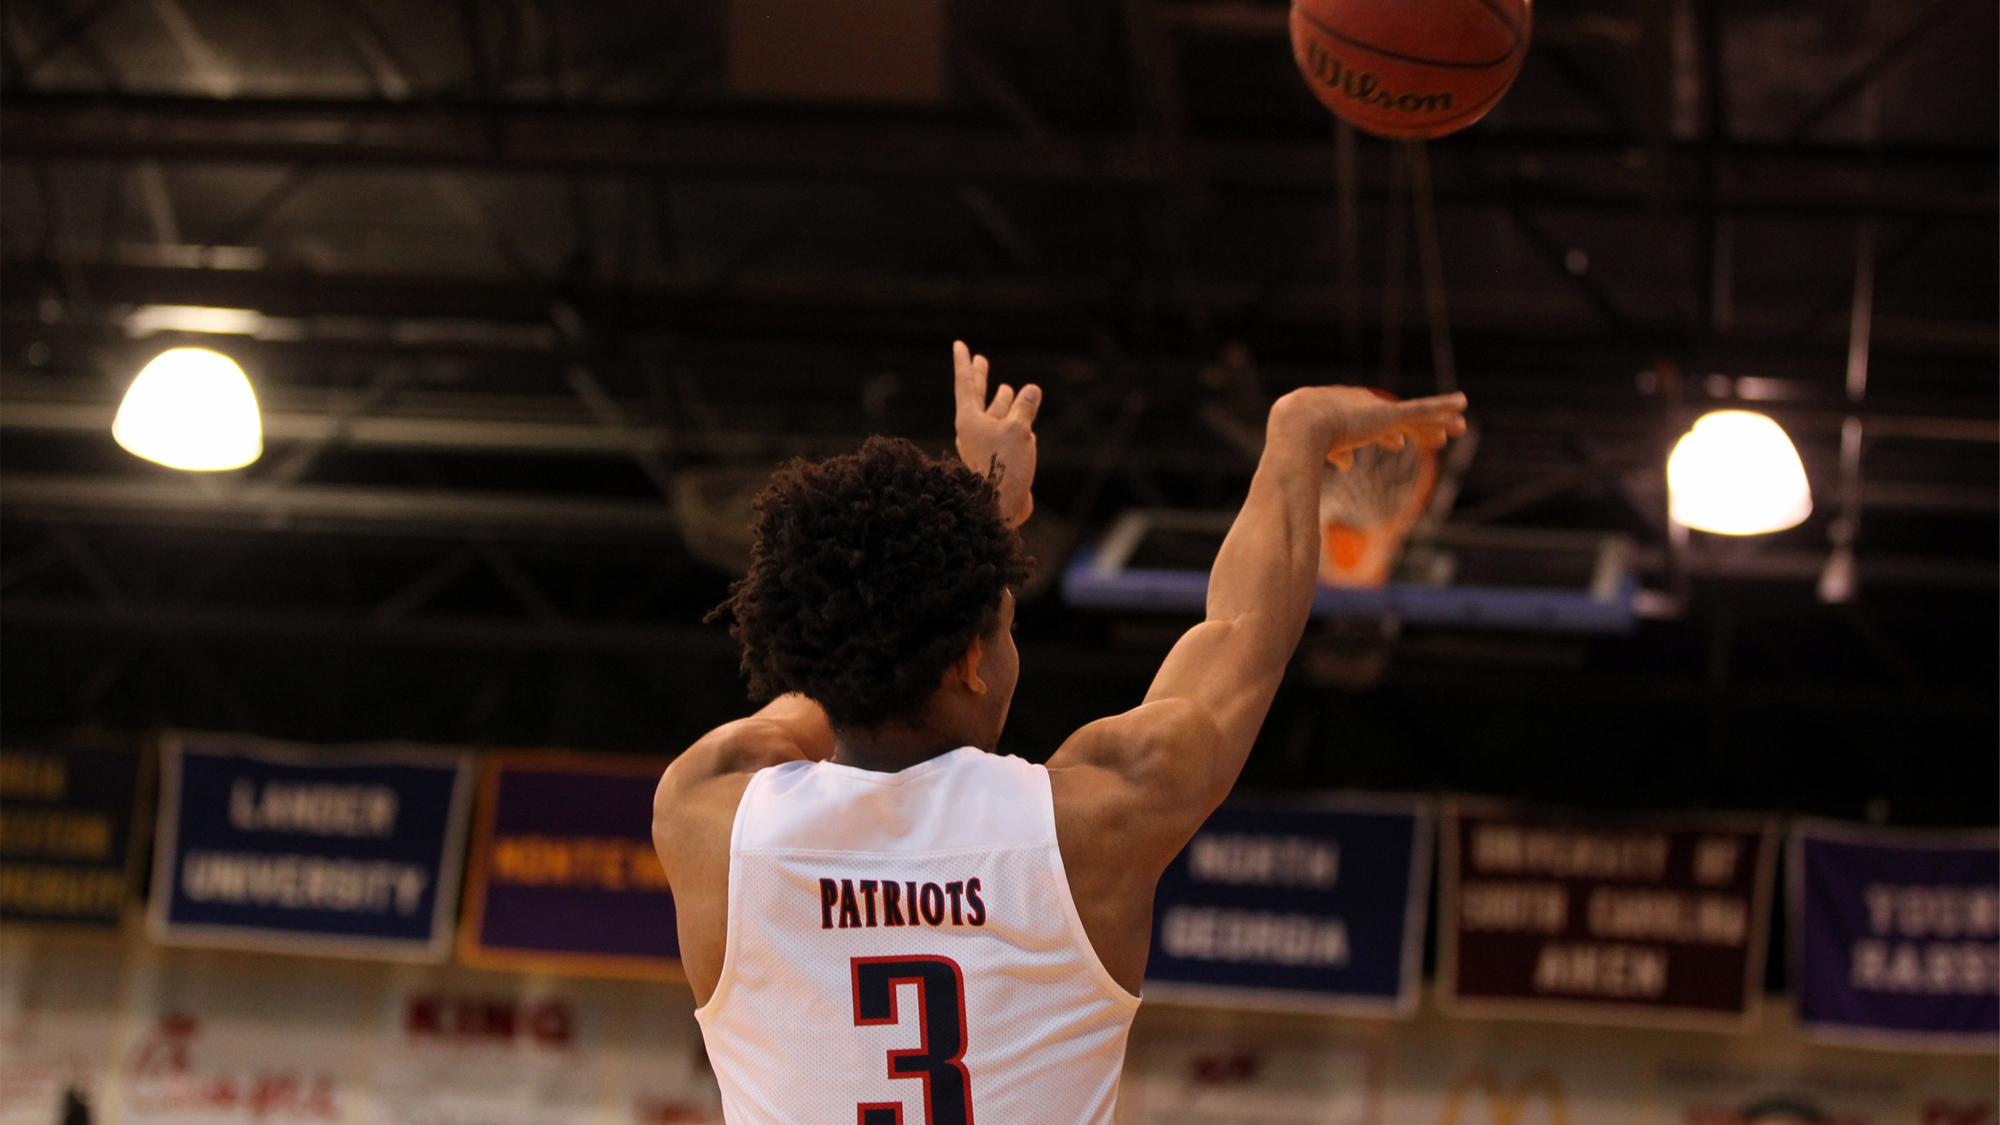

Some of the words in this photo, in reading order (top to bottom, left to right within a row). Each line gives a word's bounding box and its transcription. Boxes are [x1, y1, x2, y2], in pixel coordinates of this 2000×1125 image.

[1307, 38, 1453, 112] Wilson
[230, 781, 397, 837] LANDER
[1190, 834, 1338, 887] NORTH
[1473, 828, 1666, 877] UNIVERSITY
[184, 854, 428, 914] UNIVERSITY
[819, 878, 986, 929] PATRIOTS
[1867, 886, 2000, 934] YOUN
[1163, 908, 1348, 965] GEORGIA
[1590, 889, 1744, 943] CAROLINA
[1537, 945, 1667, 995] AIKEN
[405, 995, 573, 1047] KING
[850, 954, 975, 1125] 3
